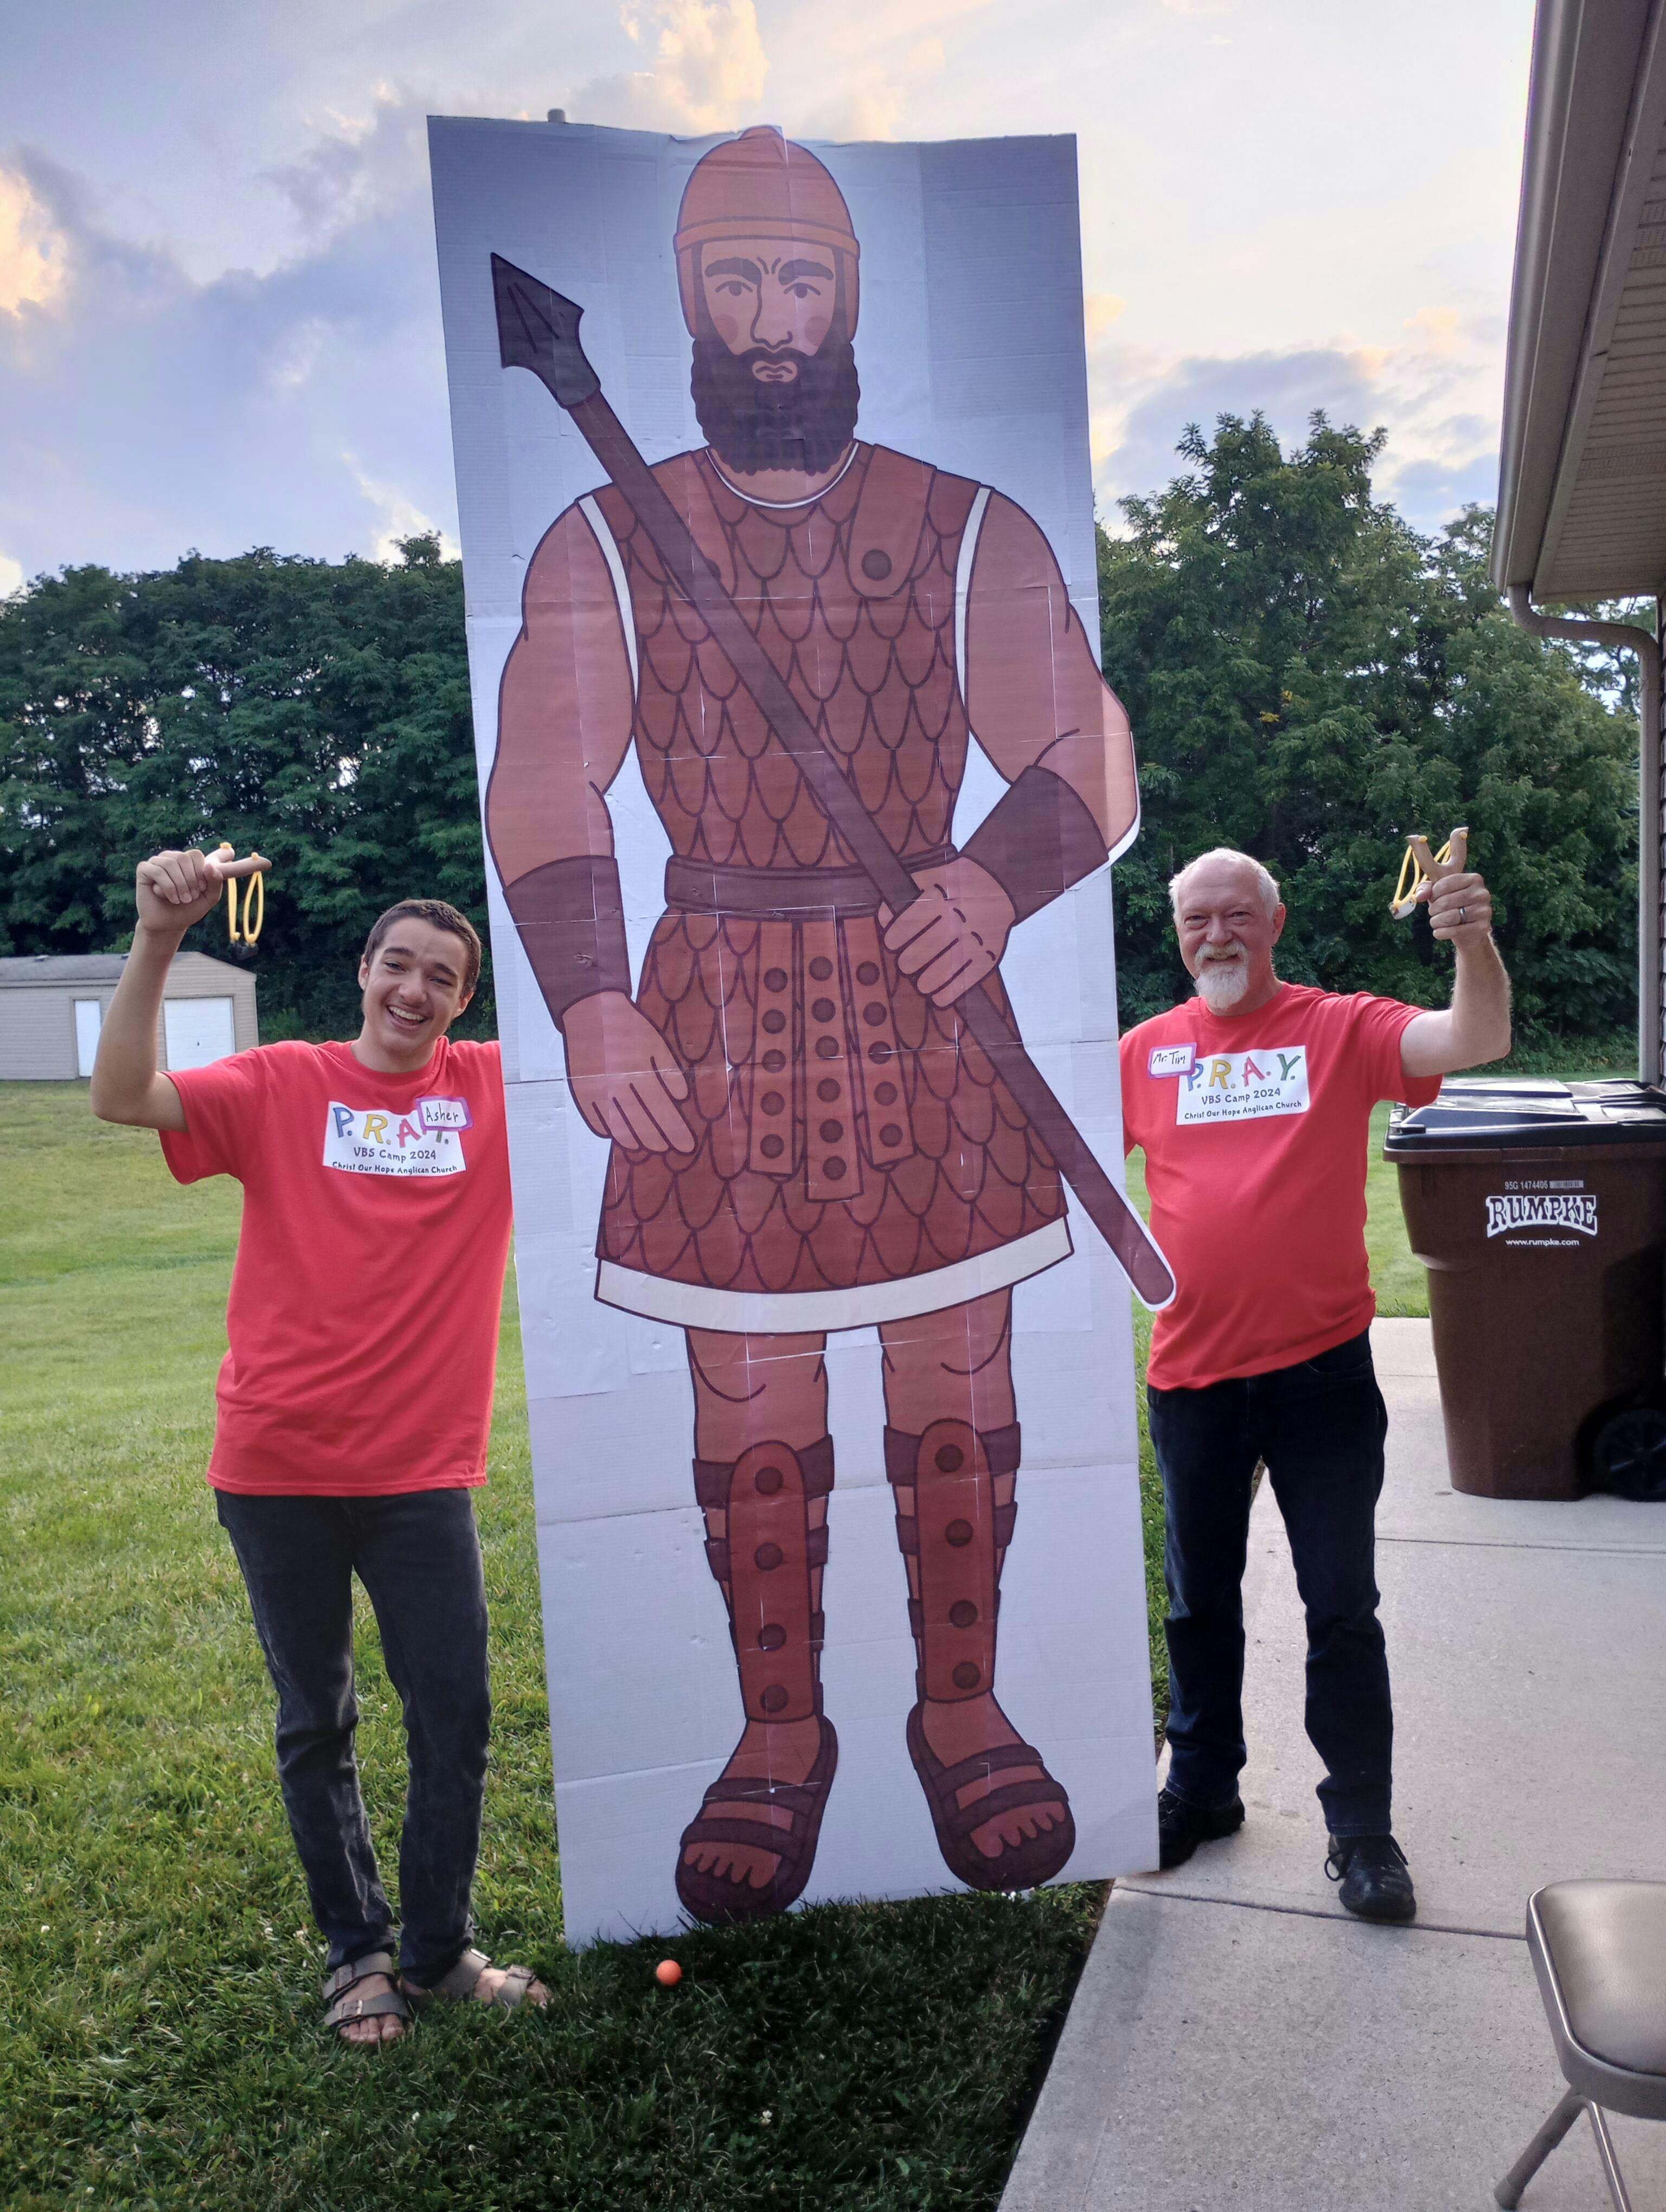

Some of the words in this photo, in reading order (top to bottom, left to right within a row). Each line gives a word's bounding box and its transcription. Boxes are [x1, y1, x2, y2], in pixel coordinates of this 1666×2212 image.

[1169, 1050, 1186, 1065] Tim
[1201, 1094, 1221, 1105] VBS
[1225, 1094, 1250, 1103] Camp
[1253, 1088, 1280, 1099] 2024
[426, 1103, 459, 1122] Asher
[1184, 1111, 1204, 1120] Christ
[1207, 1109, 1220, 1117] Our
[1222, 1108, 1240, 1117] Hope
[1242, 1103, 1273, 1114] Anglican
[1276, 1099, 1302, 1109] Church
[353, 1147, 375, 1158] VBS
[379, 1149, 407, 1163] Camp
[409, 1150, 436, 1160] 2024
[332, 1161, 356, 1171] Christ
[375, 1165, 395, 1173] Hope
[398, 1166, 429, 1175] Anglican
[431, 1165, 457, 1174] Church
[1504, 1181, 1518, 1190] 95G
[1485, 1195, 1598, 1238] RUMPKE
[1505, 1238, 1579, 1247] www.rumpke.com
